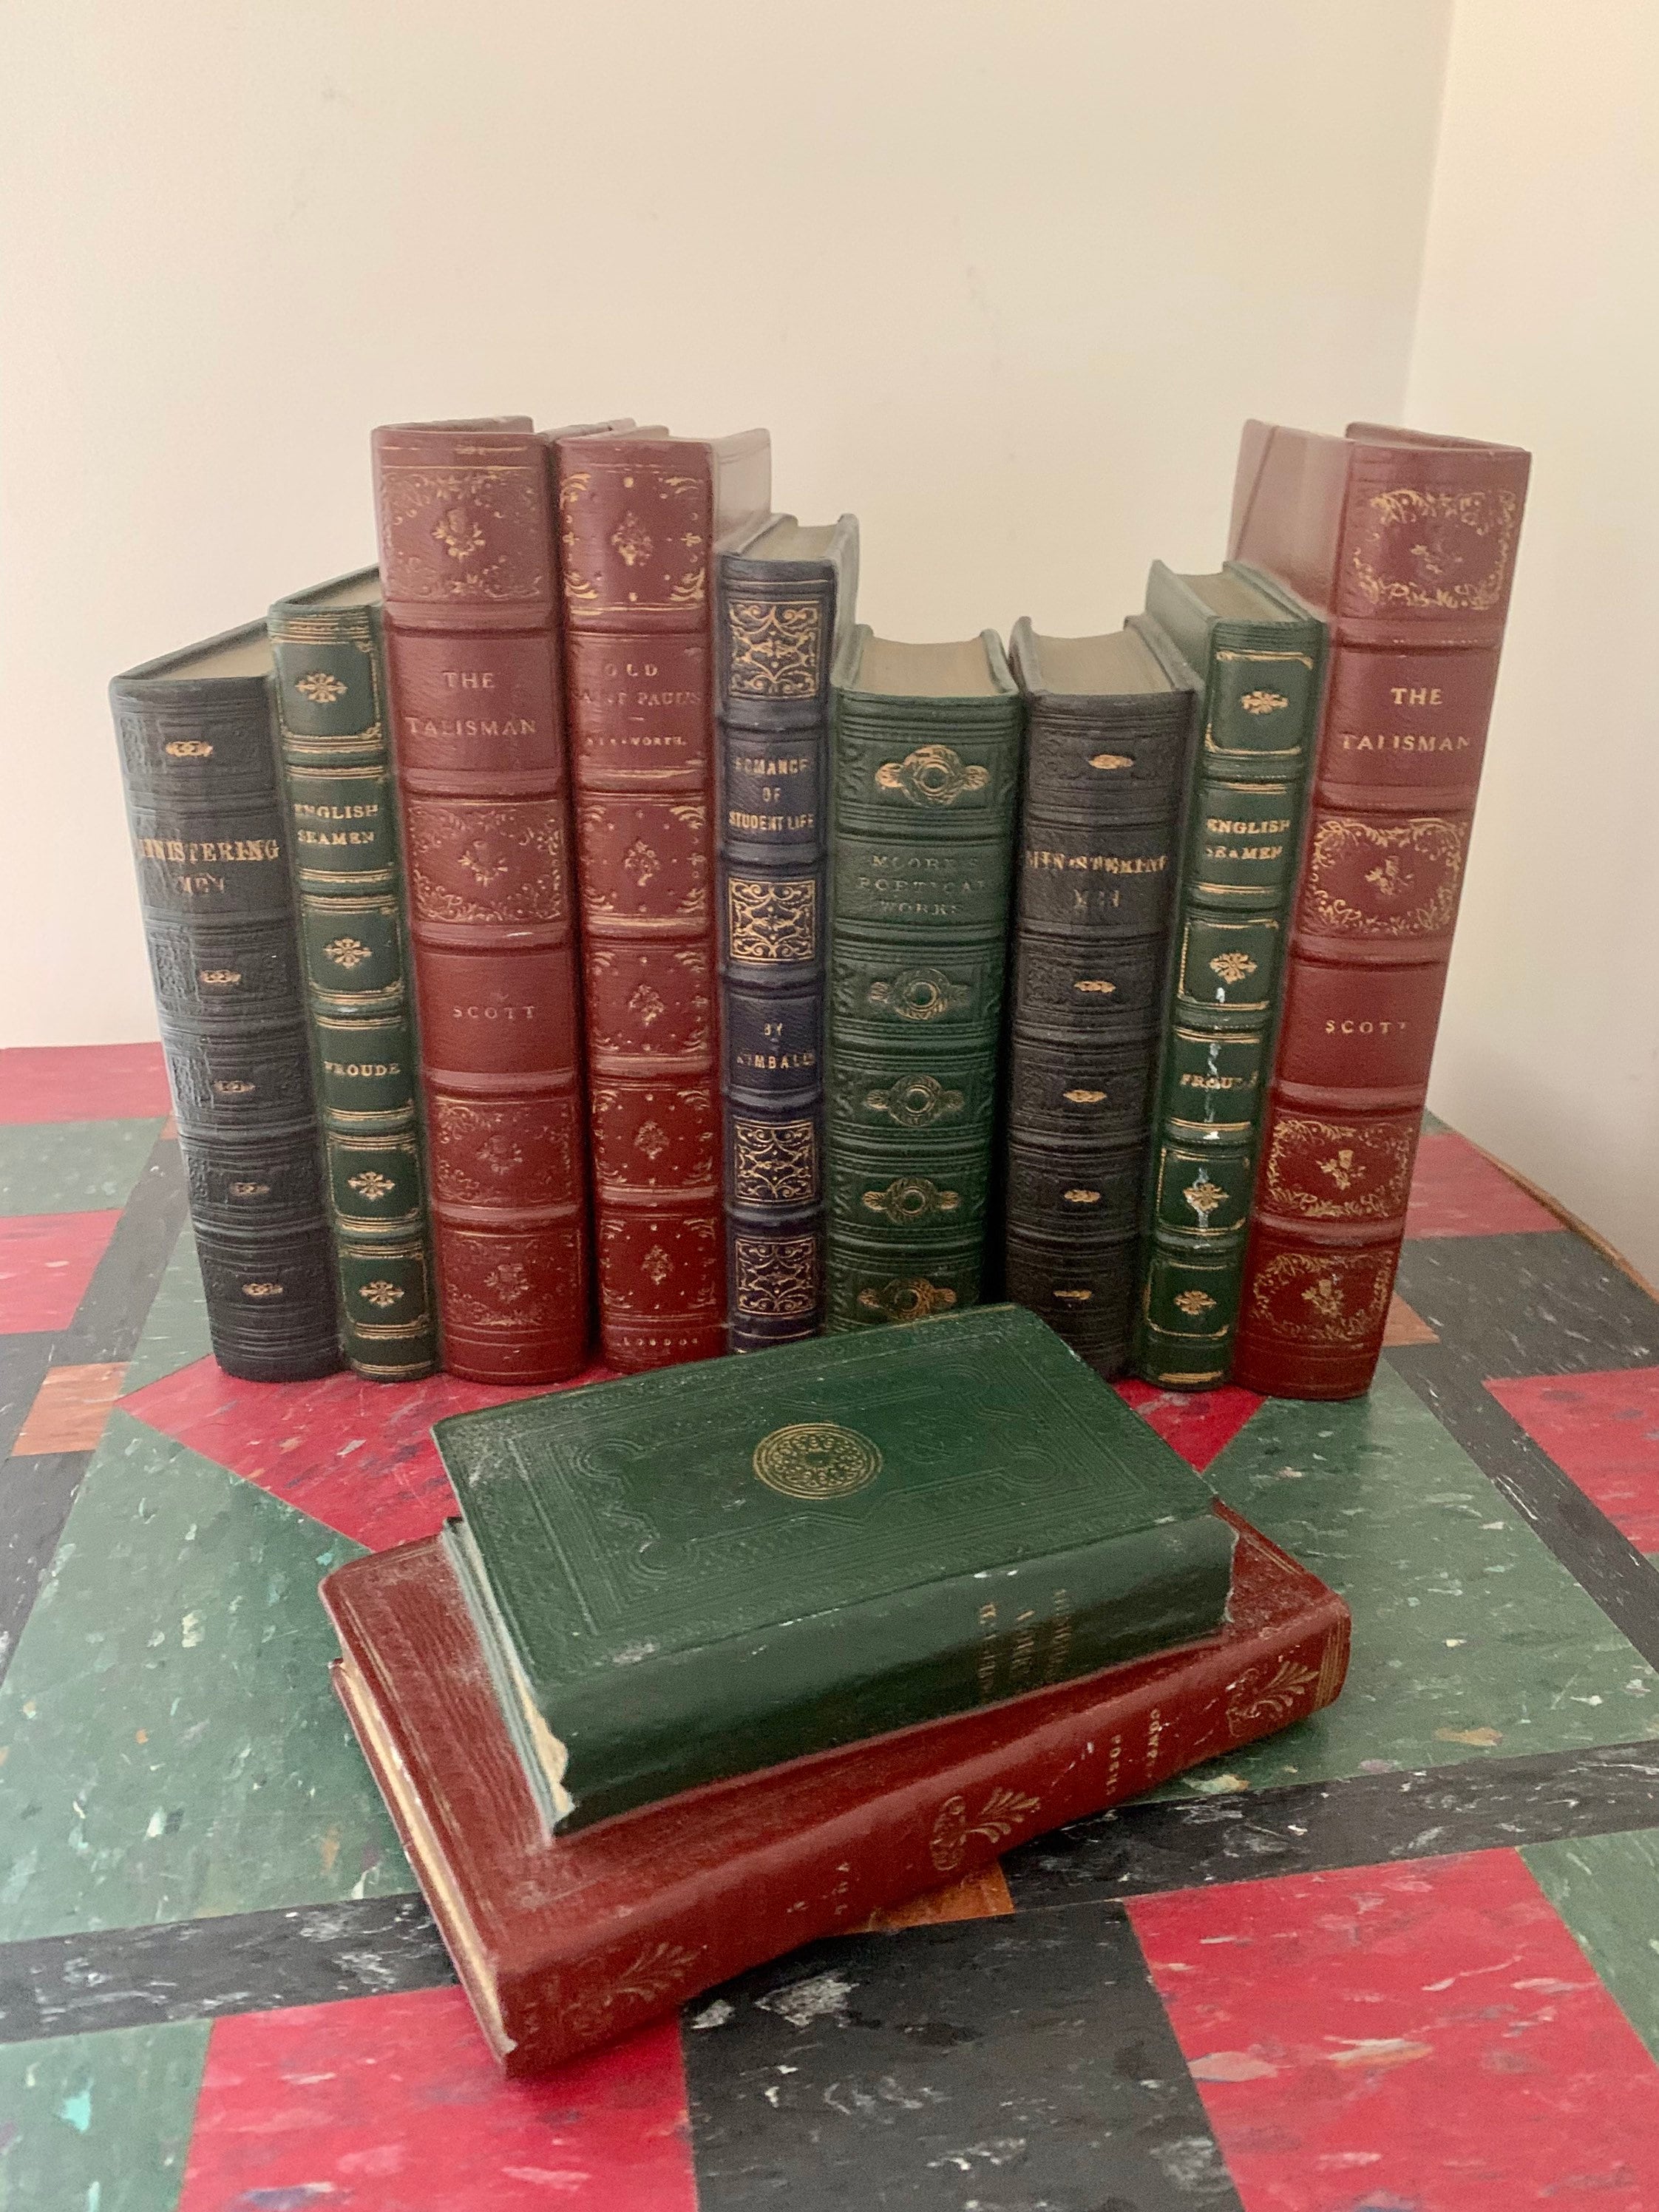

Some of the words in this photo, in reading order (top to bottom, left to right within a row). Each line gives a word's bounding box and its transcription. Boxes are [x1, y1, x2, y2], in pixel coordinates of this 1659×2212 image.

[442, 671, 495, 689] THE
[1390, 686, 1444, 705] THE
[404, 716, 537, 736] TALISMAN
[293, 803, 379, 819] ENGLISH
[728, 811, 784, 832] STUDENT
[1206, 818, 1291, 835] ENGLISH
[297, 830, 375, 845] SEAMEN
[871, 855, 979, 870] MOORES
[452, 1005, 535, 1020] SCOTT
[1325, 1020, 1406, 1034] SCOTT
[324, 1059, 401, 1077] FROUDE
[1180, 1071, 1258, 1090] FROU
